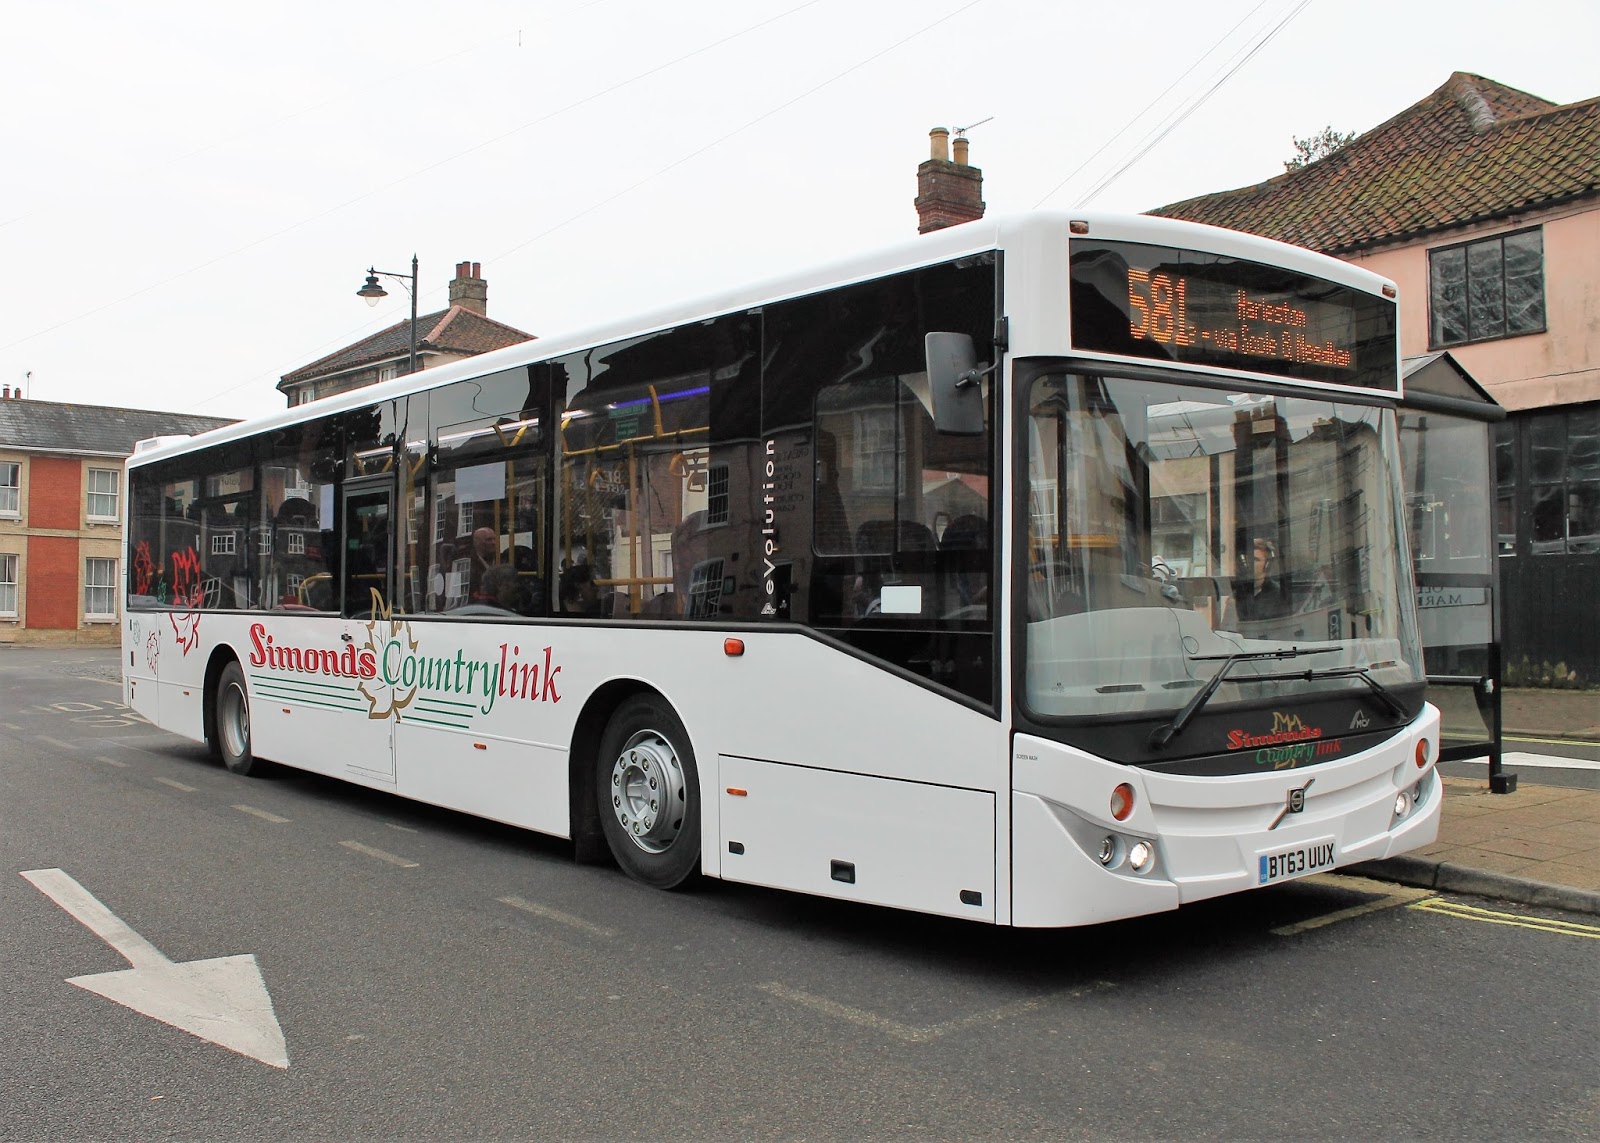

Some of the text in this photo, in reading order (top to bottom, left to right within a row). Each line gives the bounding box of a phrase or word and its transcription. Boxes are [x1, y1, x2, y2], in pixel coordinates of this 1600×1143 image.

[1127, 268, 1189, 346] 581
[1237, 289, 1306, 328] Harleston
[1214, 328, 1238, 350] via
[1241, 324, 1277, 355] Scole
[249, 622, 562, 716] Simonds Countrylink
[1226, 726, 1323, 750] Simonds
[1268, 842, 1335, 879] BT63 UUX
